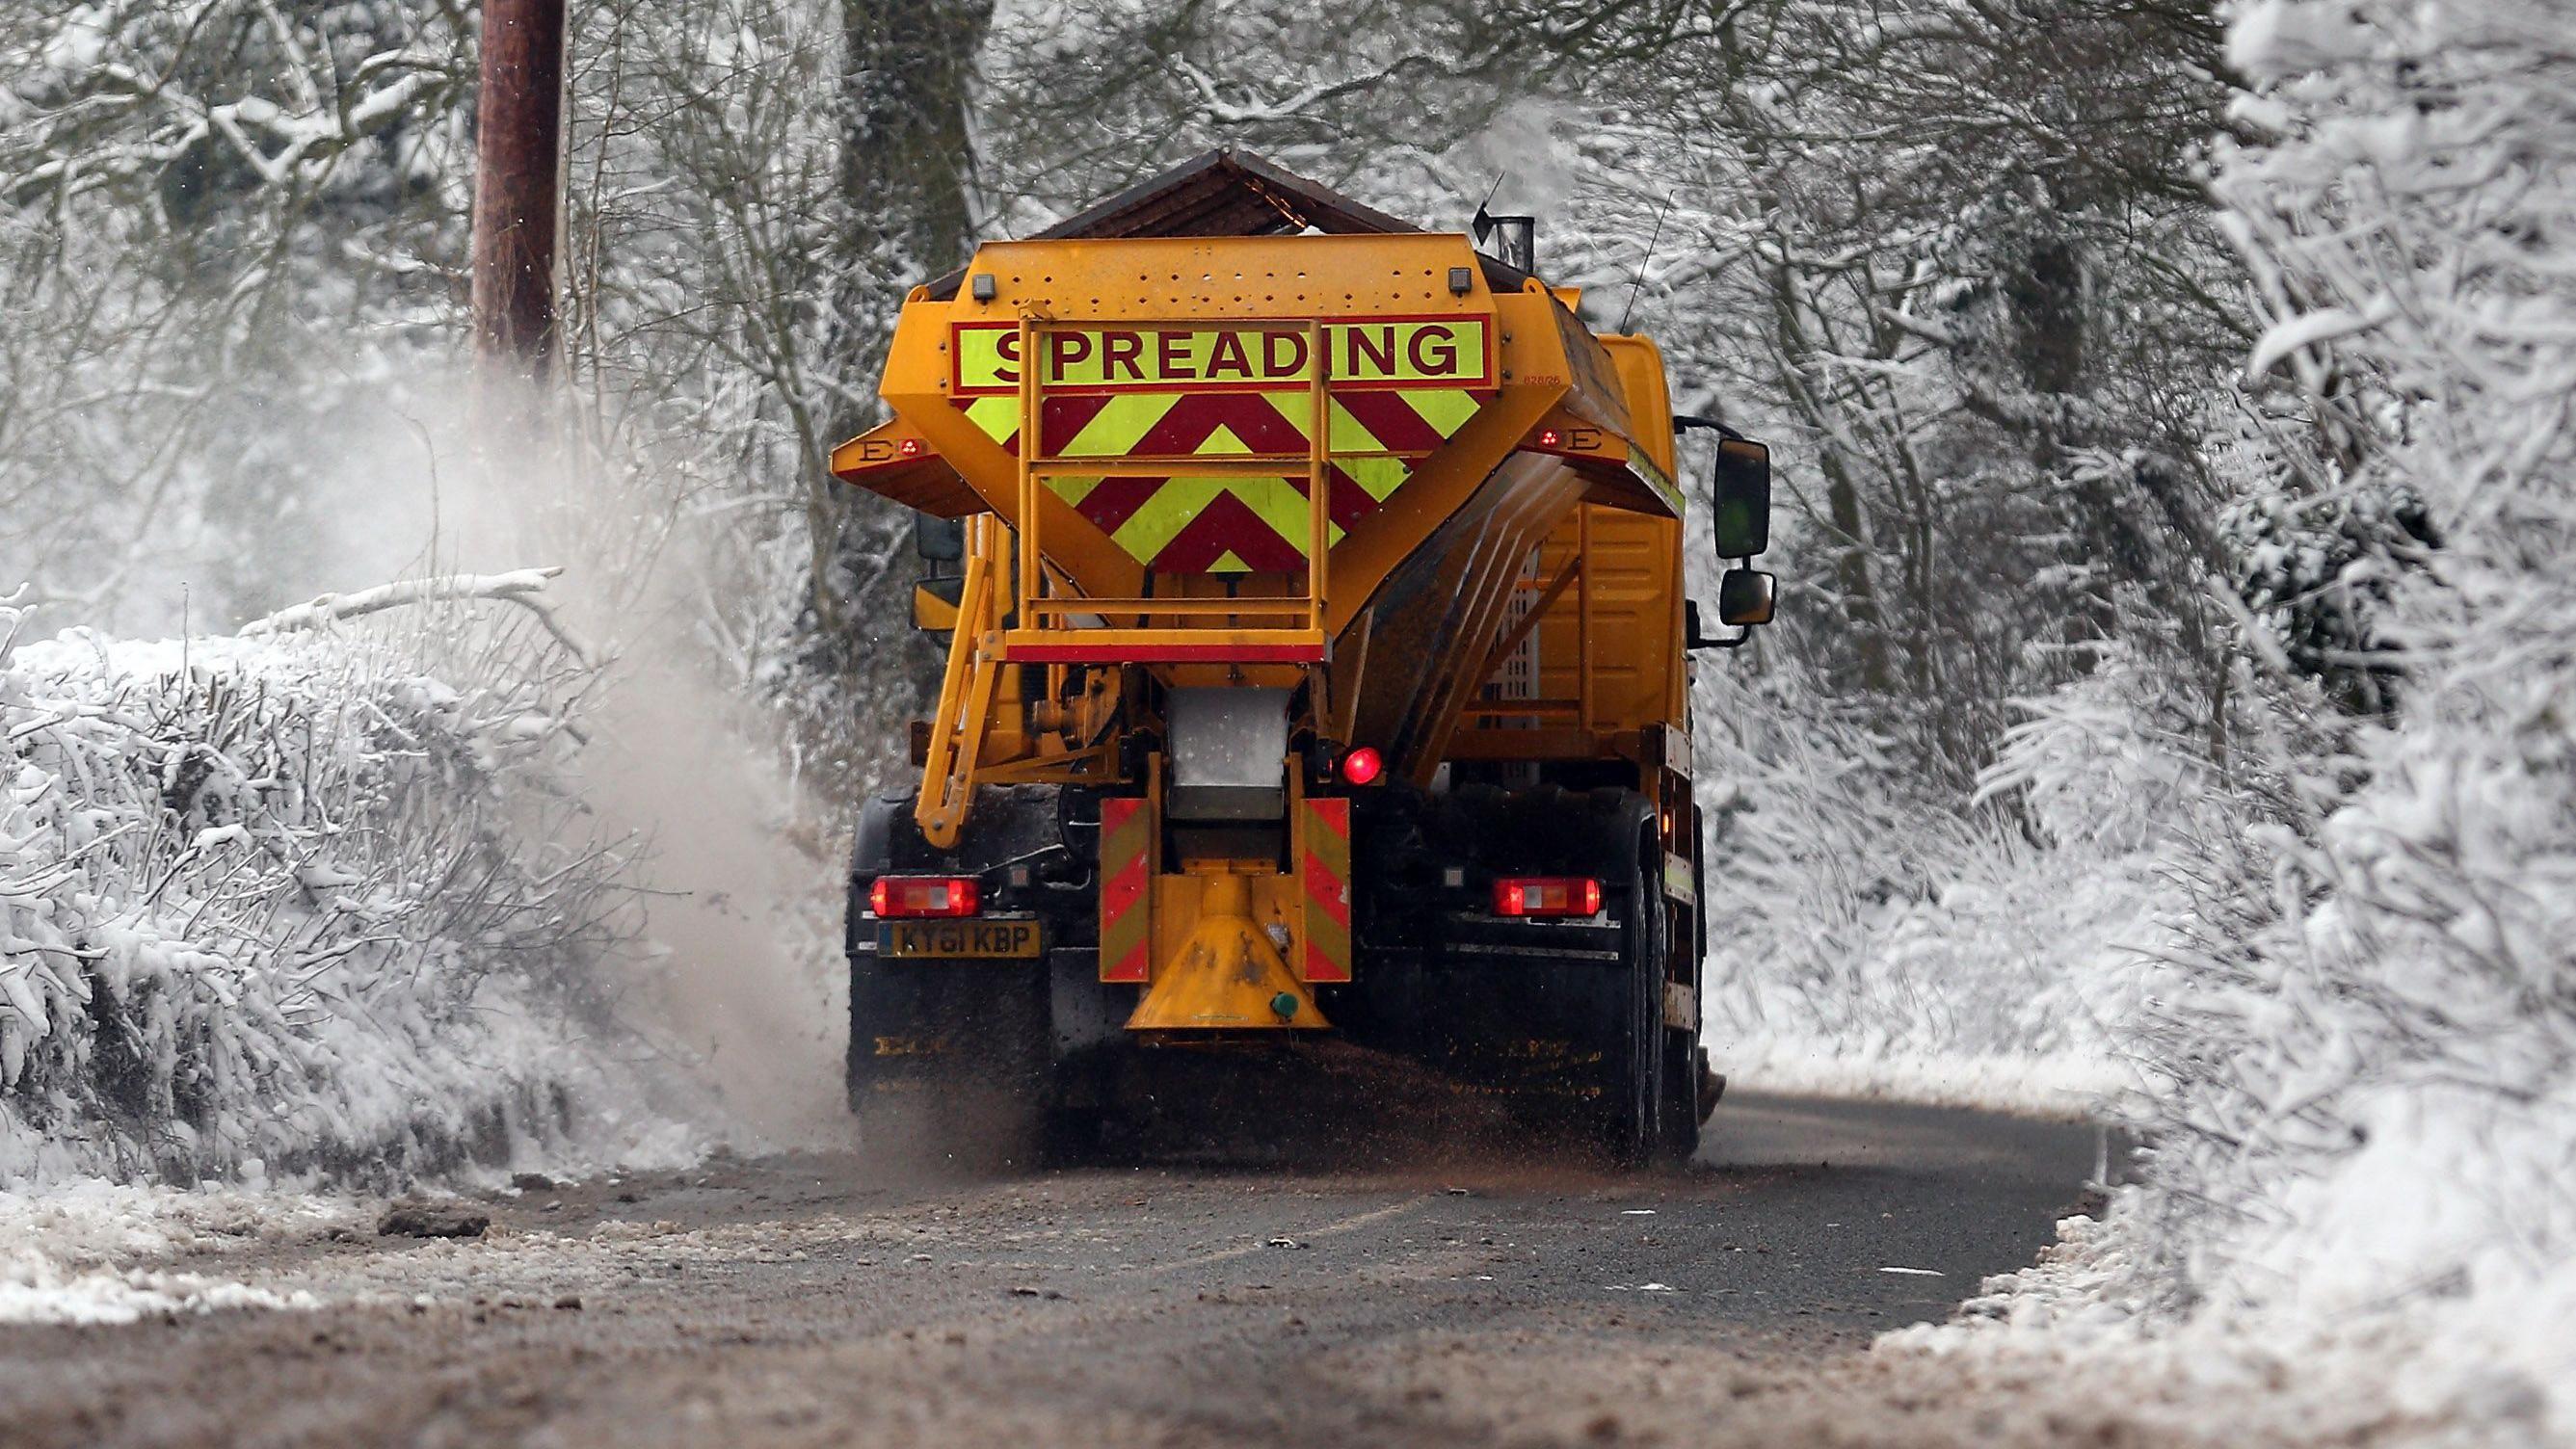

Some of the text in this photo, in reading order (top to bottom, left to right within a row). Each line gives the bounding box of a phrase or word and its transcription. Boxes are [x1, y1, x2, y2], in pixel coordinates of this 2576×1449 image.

[993, 325, 1457, 382] SPREADING
[901, 925, 1031, 953] KY61 KBP
